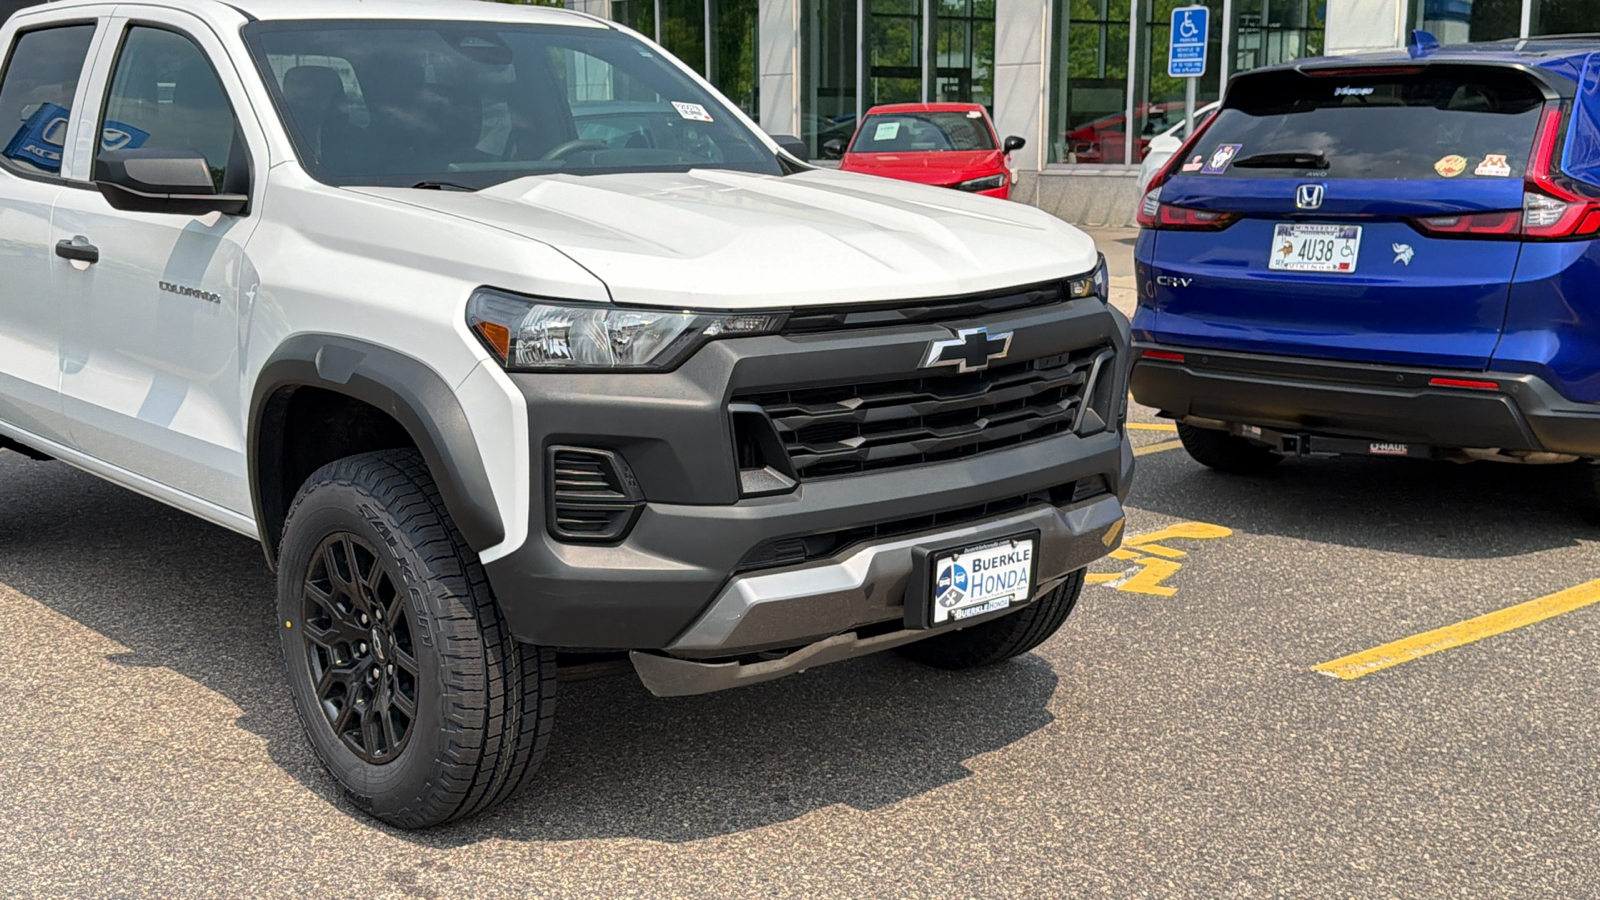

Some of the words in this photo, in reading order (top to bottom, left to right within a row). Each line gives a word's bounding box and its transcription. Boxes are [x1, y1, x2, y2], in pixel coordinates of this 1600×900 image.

[1297, 239, 1335, 262] 4U38
[158, 280, 221, 304] COLORADO
[1156, 275, 1193, 287] CR-V
[1370, 442, 1408, 452] U-HAUL
[972, 549, 1030, 573] BUERKLE
[970, 566, 1028, 598] HONDA
[954, 603, 989, 619] BUERKLE
[989, 599, 1009, 610] HONDA
